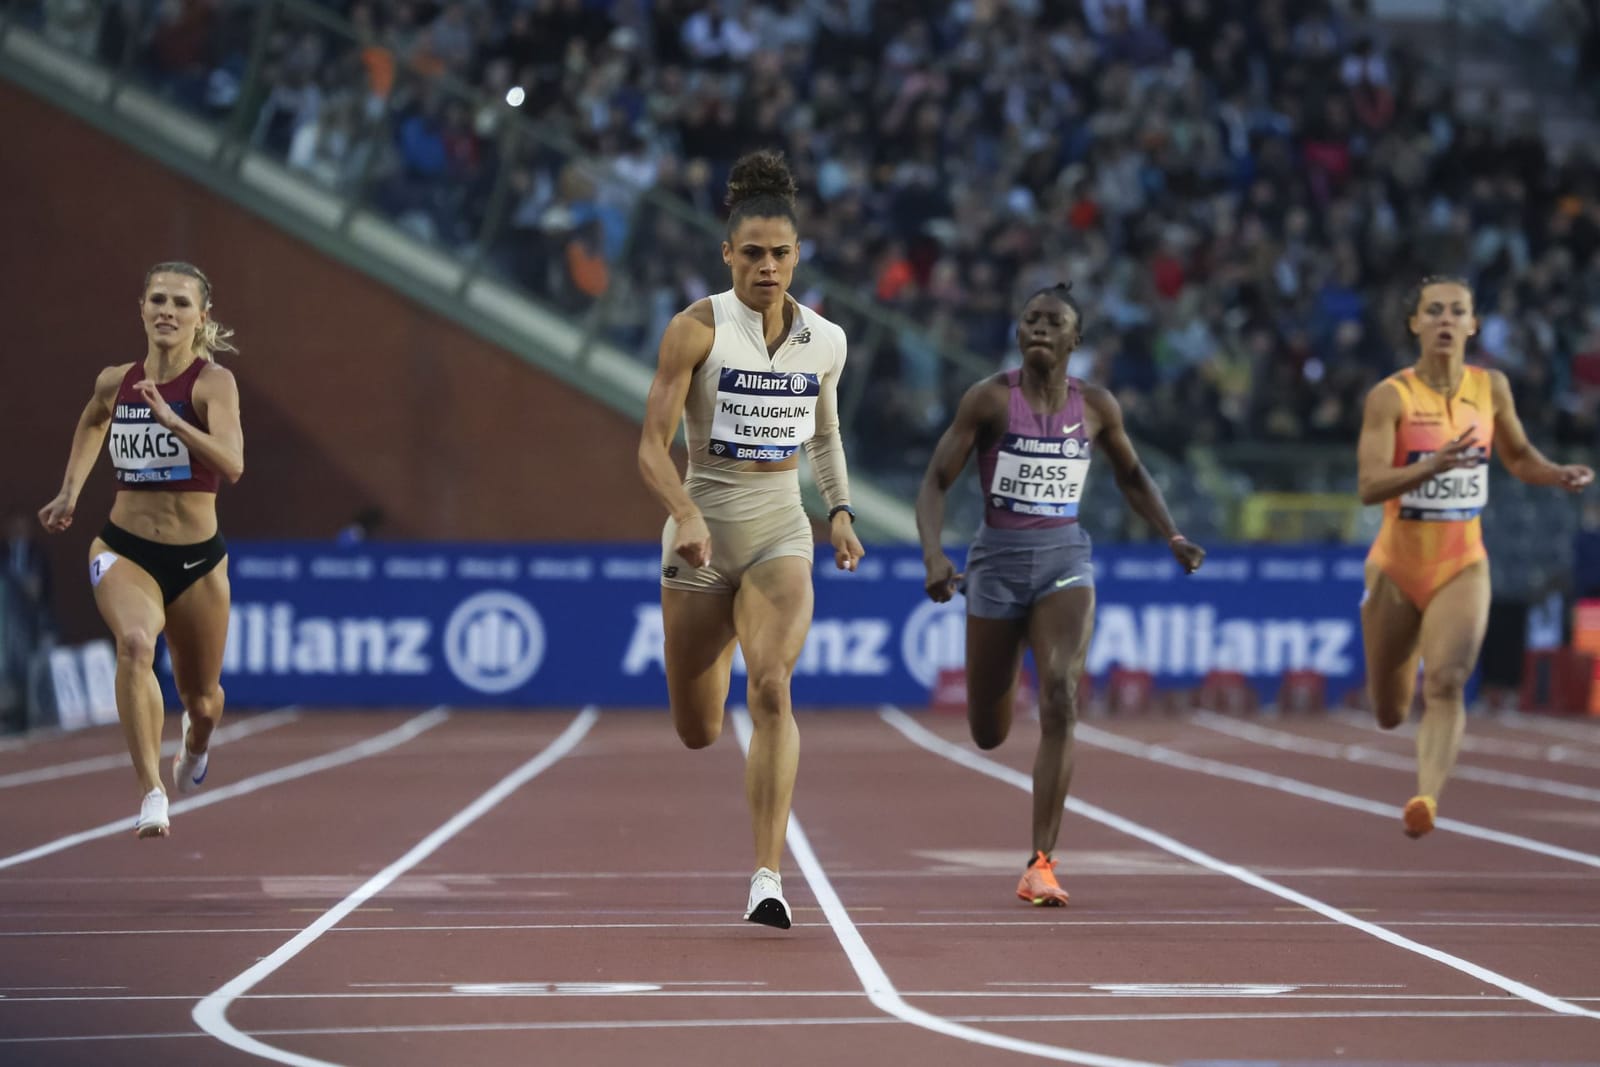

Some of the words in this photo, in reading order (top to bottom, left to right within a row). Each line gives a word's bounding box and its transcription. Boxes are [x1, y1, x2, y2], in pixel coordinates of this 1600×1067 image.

[734, 373, 788, 390] Allianz
[721, 402, 810, 418] MCLAUGHLIN-
[735, 424, 796, 438] LEVRONE
[113, 428, 179, 459] TAKÁCS
[1013, 438, 1062, 454] Allianz
[736, 447, 793, 459] BRUSSELS
[1018, 464, 1067, 480] BASS
[998, 477, 1078, 498] BITTAYE
[163, 603, 431, 674] llianz
[1084, 604, 1353, 675] Allianz
